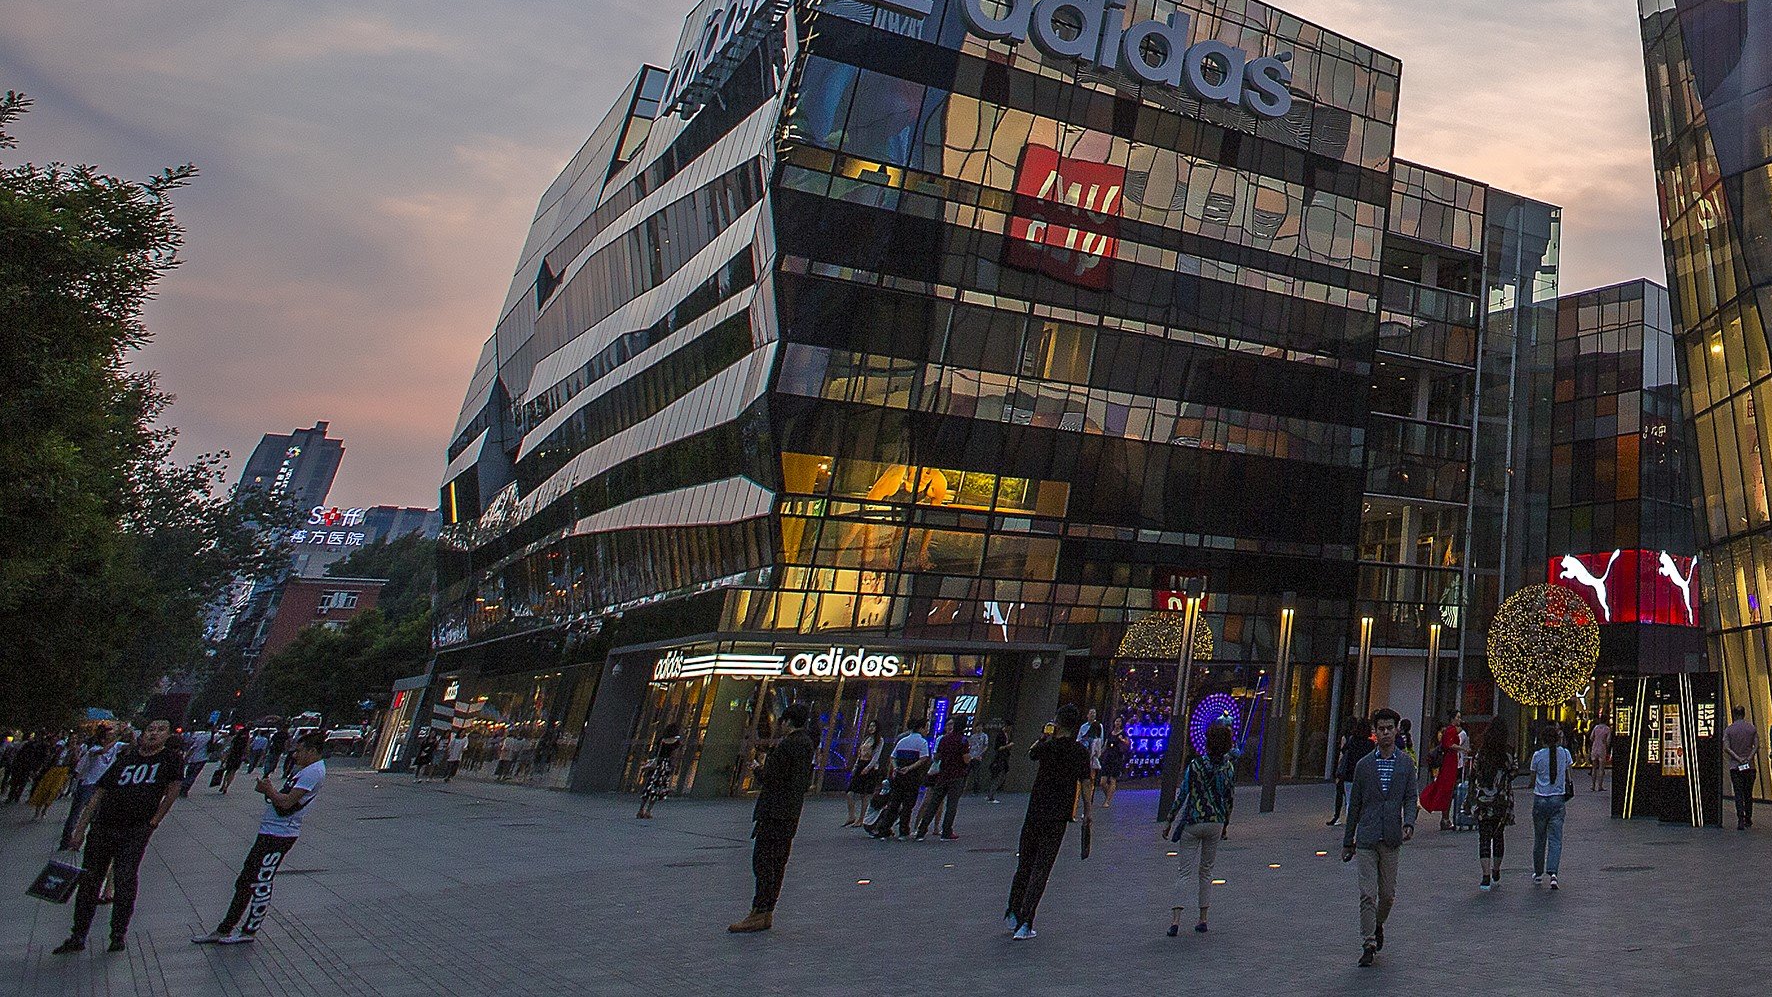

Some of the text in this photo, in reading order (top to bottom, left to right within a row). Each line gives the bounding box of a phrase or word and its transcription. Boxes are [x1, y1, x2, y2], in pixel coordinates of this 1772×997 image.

[789, 646, 899, 677] adidas
[117, 762, 160, 787] 501
[246, 851, 281, 932] adidas
